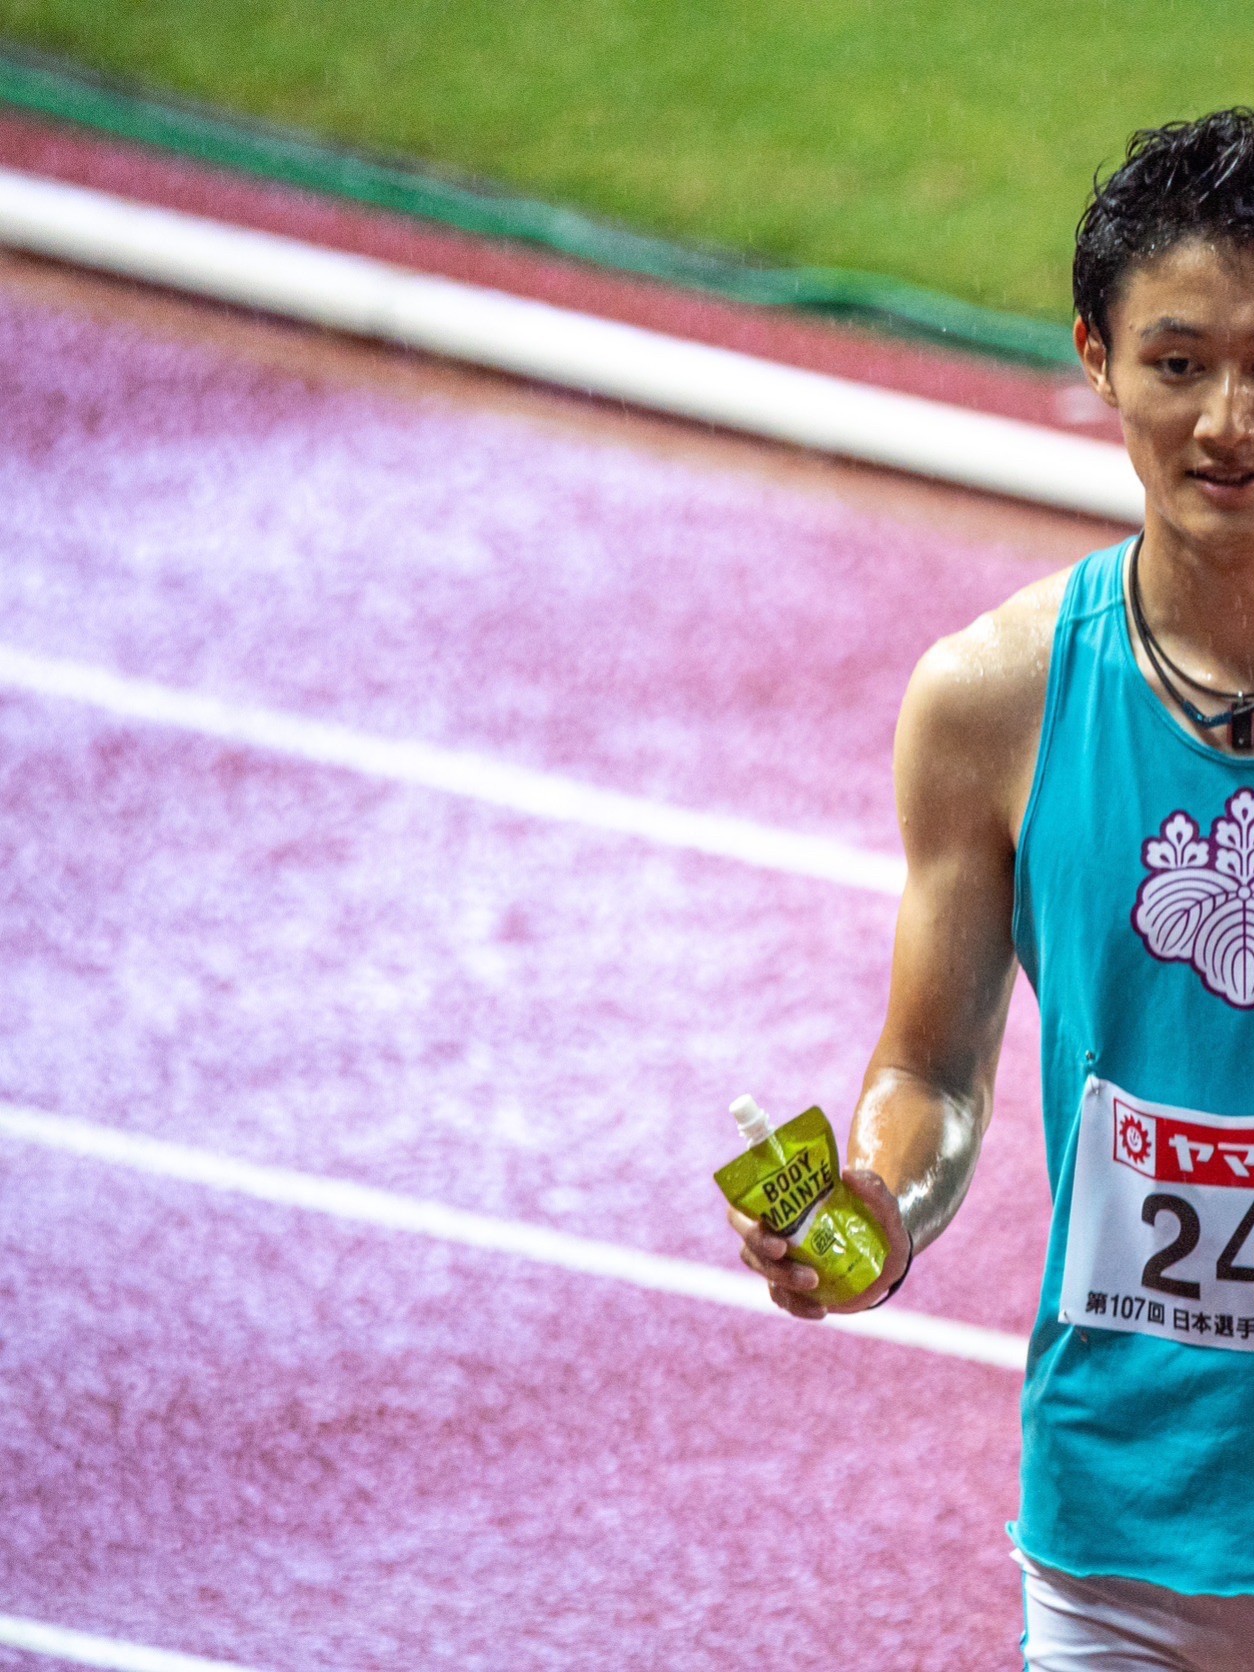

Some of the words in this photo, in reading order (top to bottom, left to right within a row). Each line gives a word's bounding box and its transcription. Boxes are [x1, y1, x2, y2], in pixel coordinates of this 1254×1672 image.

[761, 1159, 833, 1230] MAINTÉ
[762, 1151, 812, 1203] BODY
[1085, 1290, 1165, 1326] 第107回
